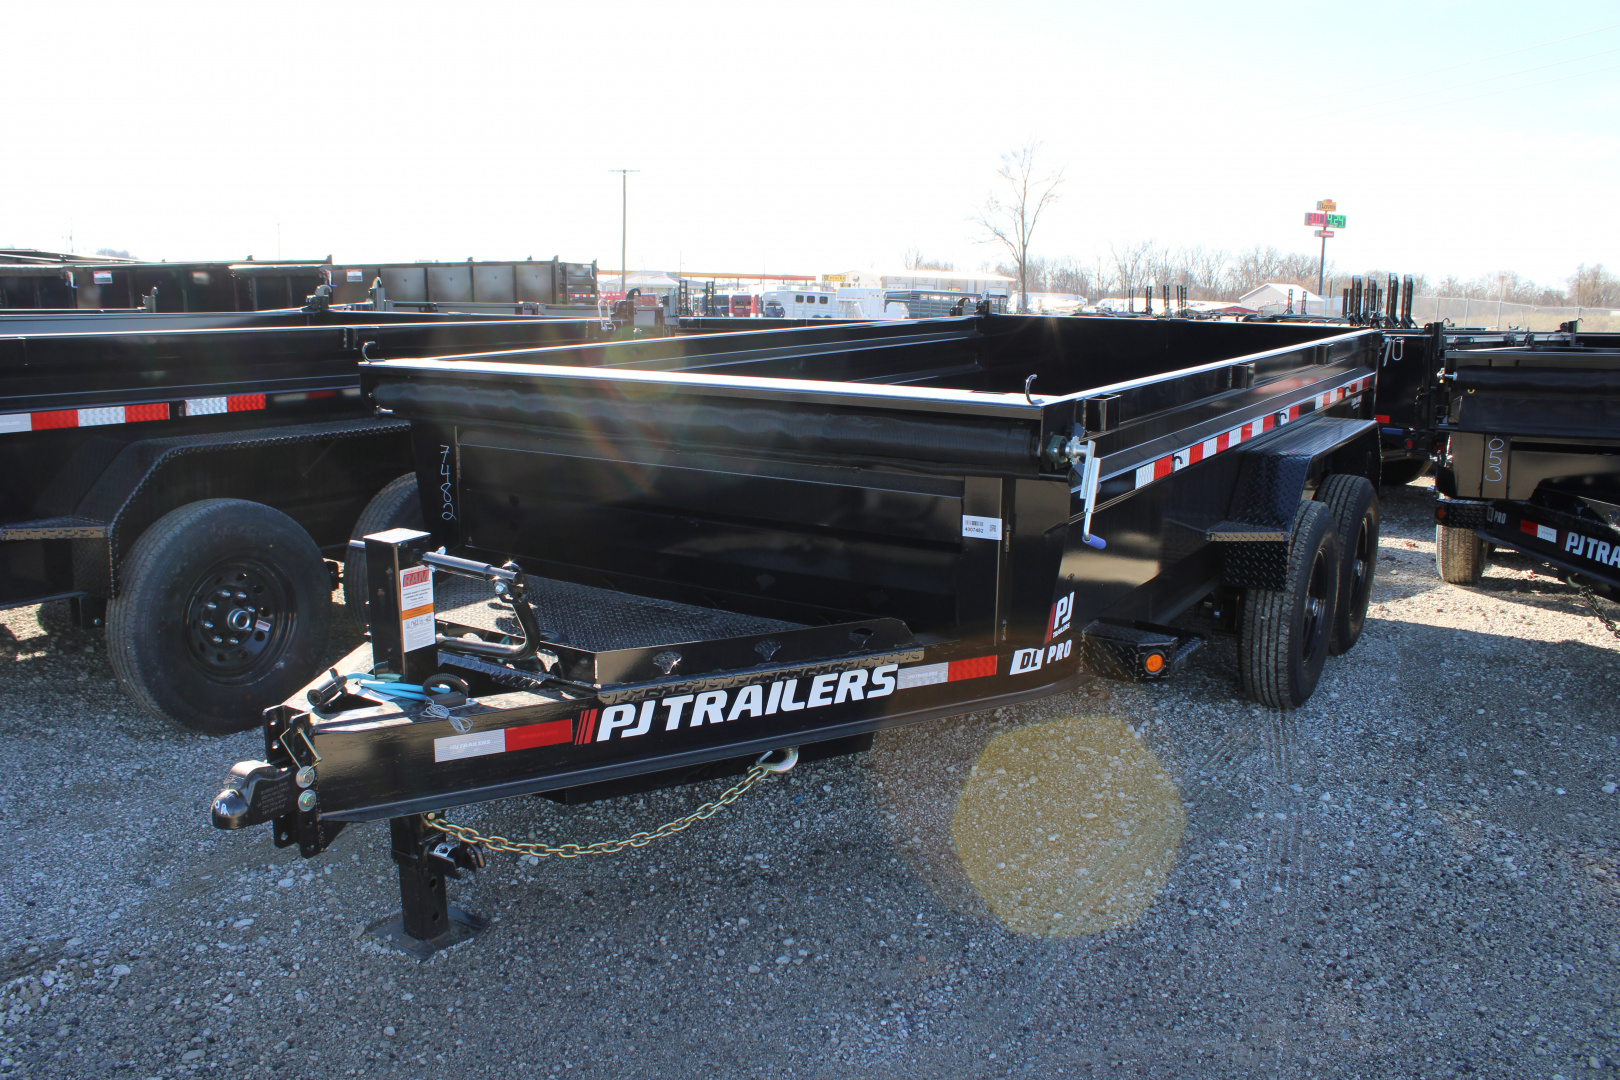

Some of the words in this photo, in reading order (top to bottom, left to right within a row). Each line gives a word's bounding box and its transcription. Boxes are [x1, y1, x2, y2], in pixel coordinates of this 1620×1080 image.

[440, 444, 457, 521] 7482
[1493, 510, 1507, 525] PRO
[403, 570, 429, 588] RAM
[1053, 591, 1075, 630] PJ
[1046, 639, 1072, 664] PRO
